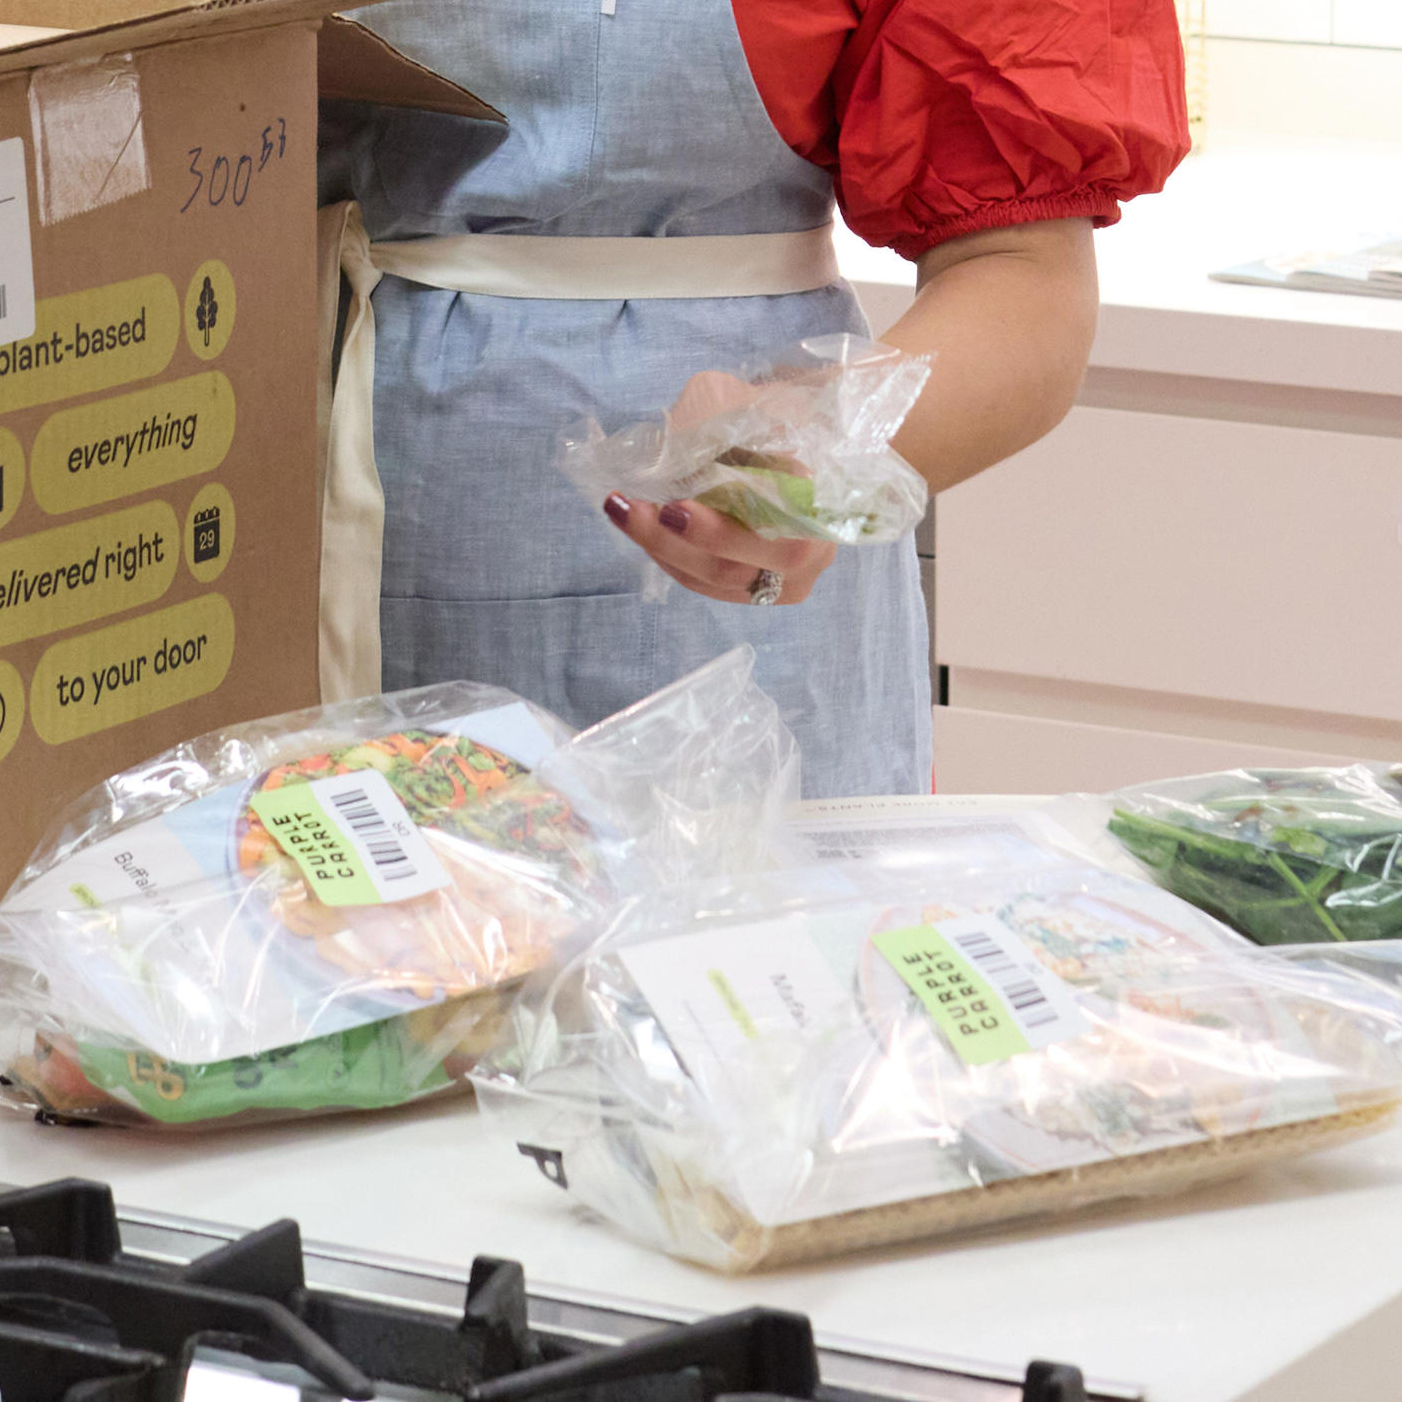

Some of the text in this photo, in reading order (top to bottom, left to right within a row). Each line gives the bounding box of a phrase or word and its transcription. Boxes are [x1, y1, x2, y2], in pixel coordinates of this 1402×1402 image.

[67, 412, 199, 474] everything
[104, 531, 166, 582] right
[199, 529, 217, 552] 29
[56, 633, 208, 707] to your door
[272, 814, 335, 881] PURPLE
[293, 811, 355, 879] CARROT
[902, 951, 979, 1037] PURPLE
[923, 948, 1000, 1033] CARROT
